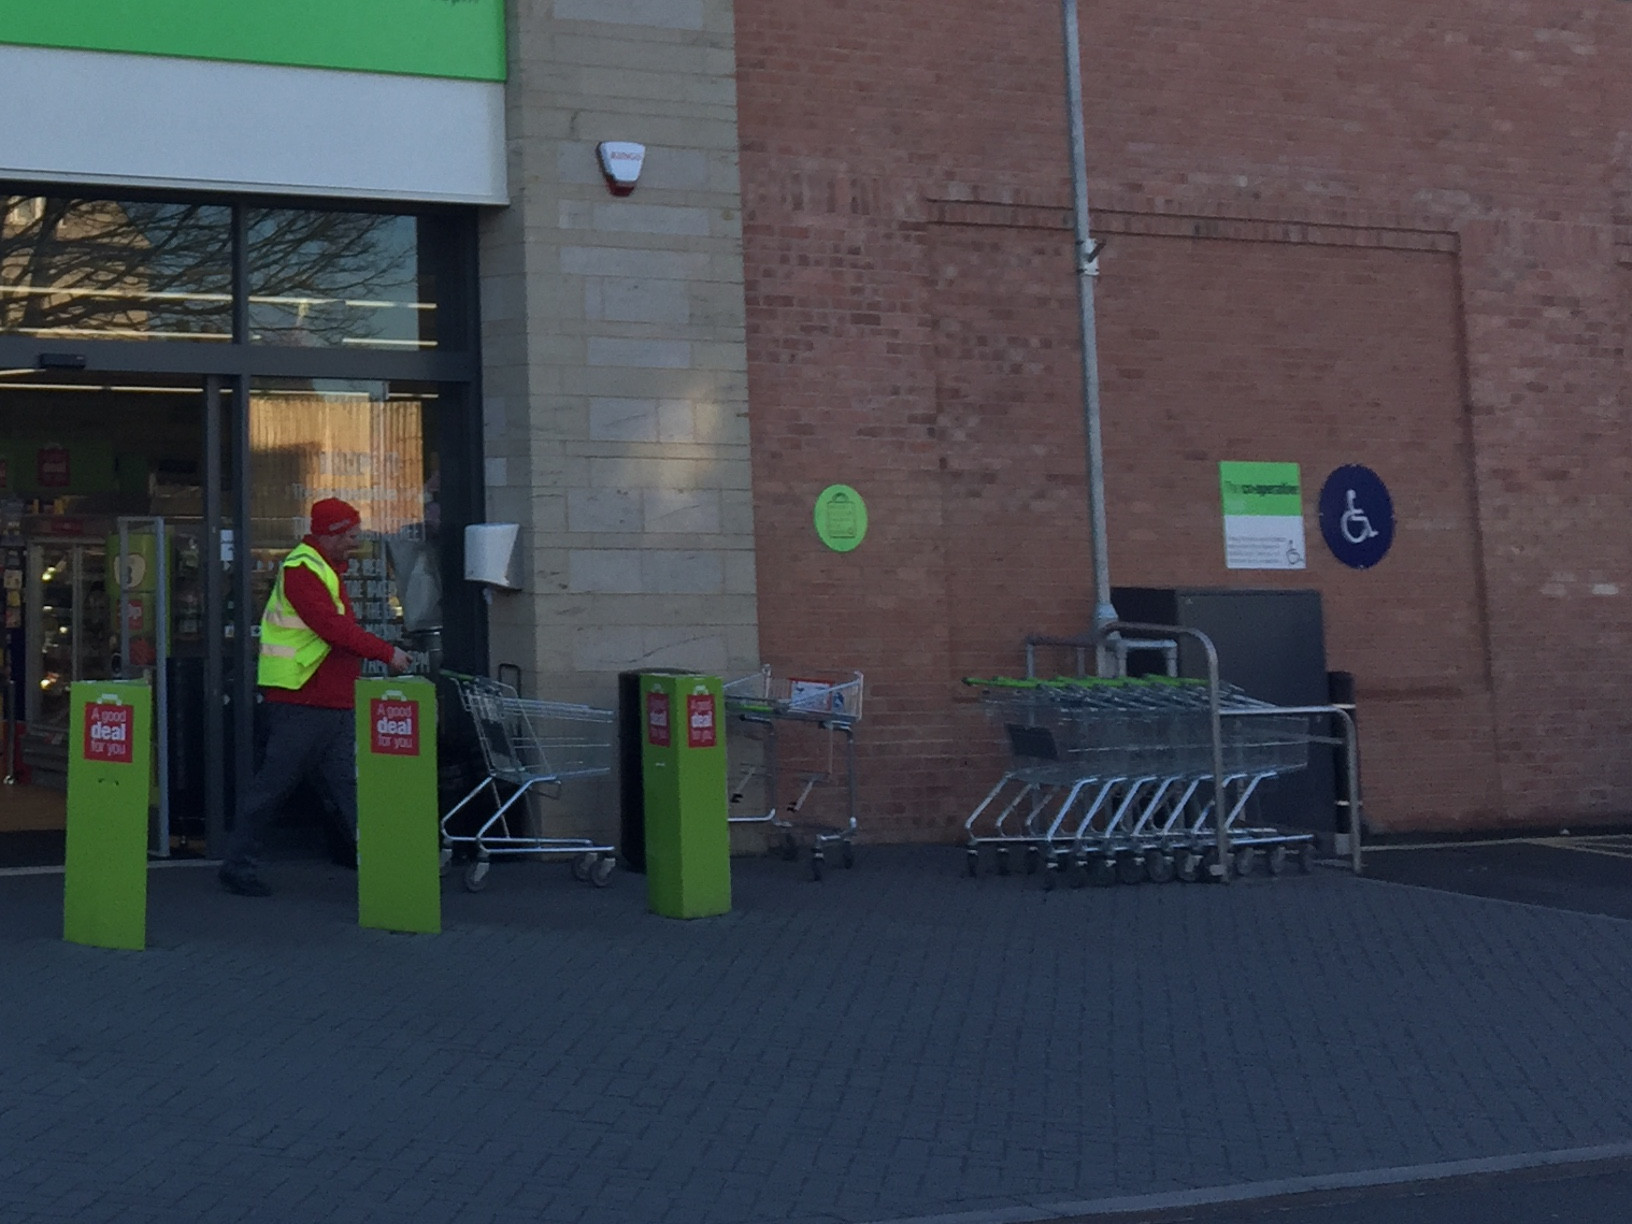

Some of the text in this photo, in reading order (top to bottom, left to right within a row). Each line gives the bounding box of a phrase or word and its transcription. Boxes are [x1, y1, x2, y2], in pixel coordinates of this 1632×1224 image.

[90, 706, 126, 723] A good
[376, 703, 412, 719] A good
[90, 720, 126, 740] deal
[376, 715, 412, 735] deal
[107, 742, 127, 756] you
[393, 737, 413, 749] you
